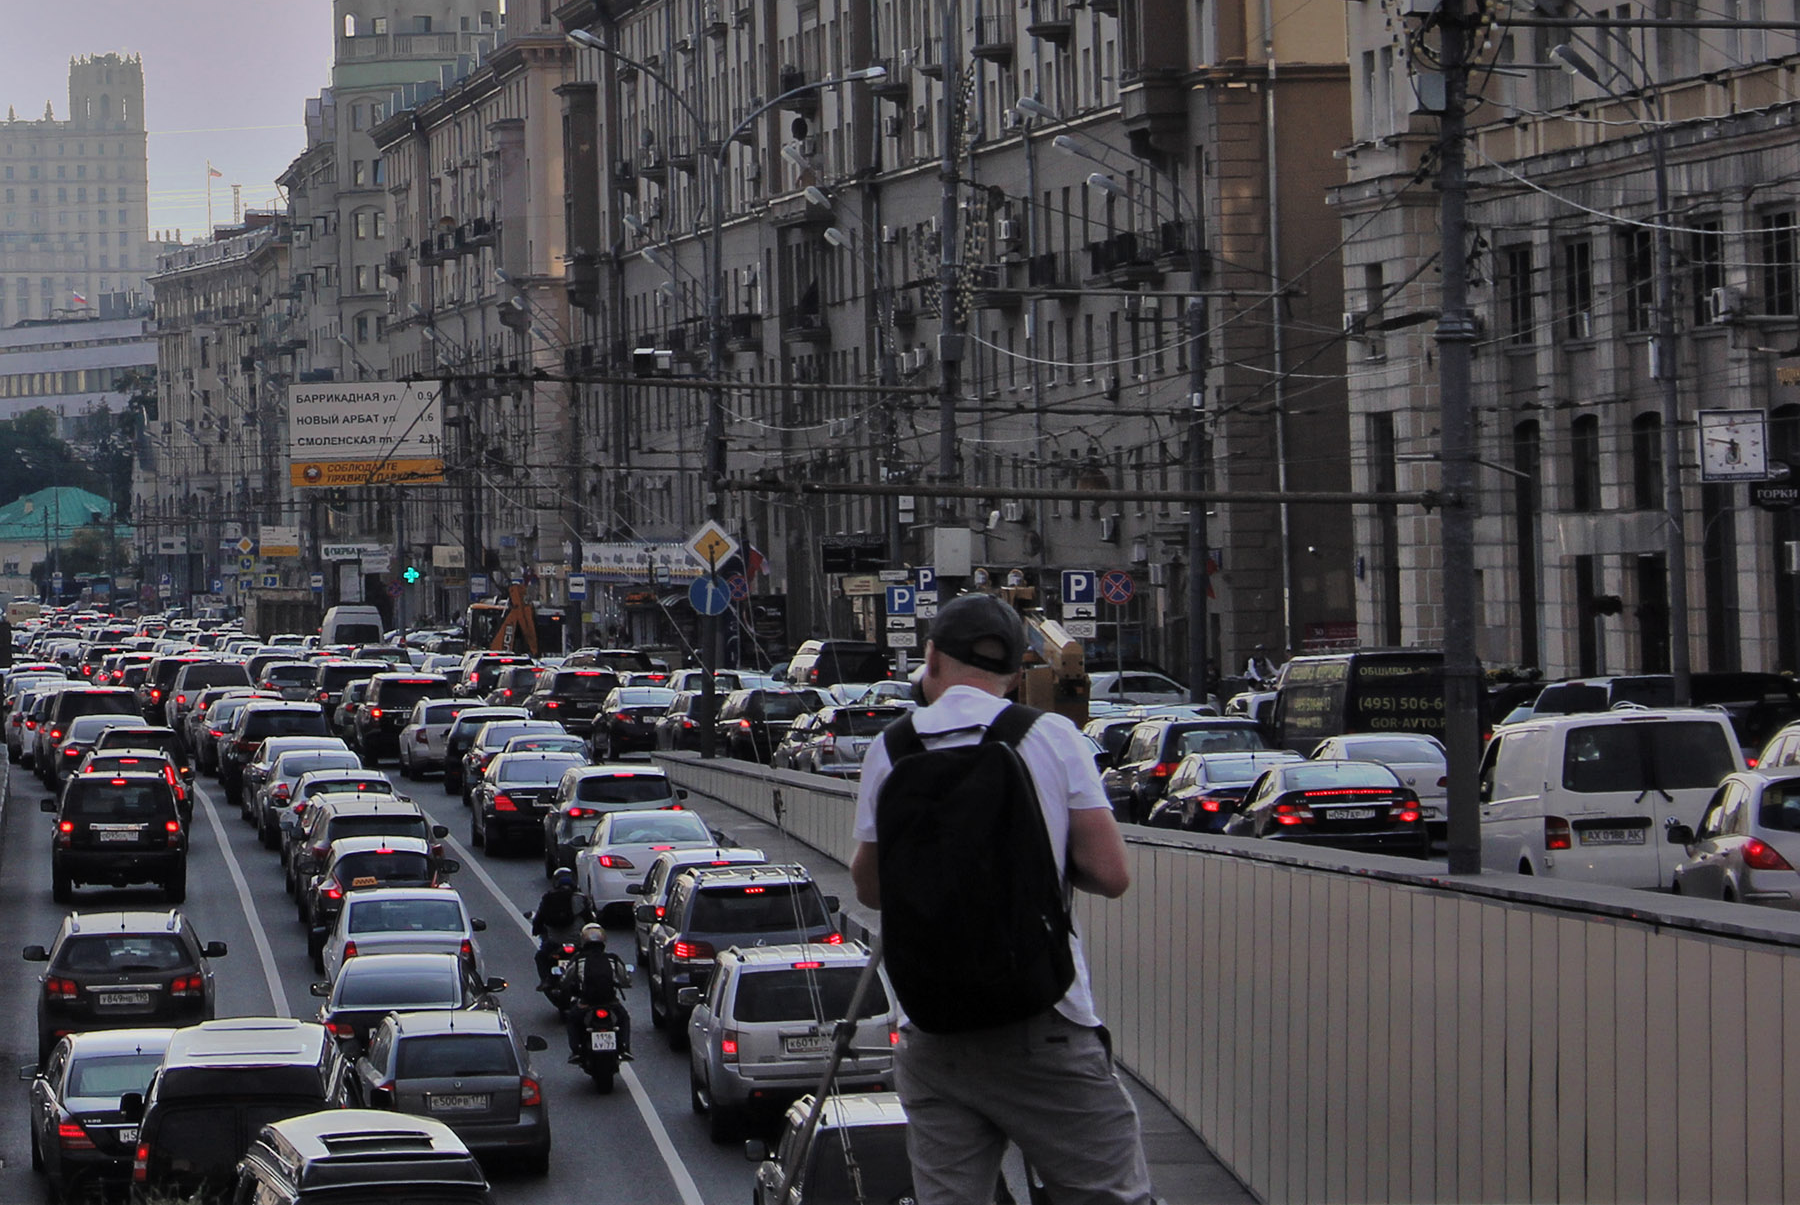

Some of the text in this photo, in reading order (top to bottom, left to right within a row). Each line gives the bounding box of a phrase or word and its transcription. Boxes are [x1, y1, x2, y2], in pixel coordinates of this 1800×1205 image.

[296, 392, 380, 404] БАРРИКАДНАЯ
[417, 391, 433, 400] 0.9
[296, 414, 339, 425] НОВЫЙ
[342, 414, 380, 424] АРБАТ
[297, 435, 376, 447] СМОЛЕНСКАЯ
[1757, 489, 1798, 498] ГОРКИ
[1359, 667, 1413, 676] ОБШИВКА
[1358, 697, 1396, 711] (495)
[789, 1037, 819, 1047] К601У
